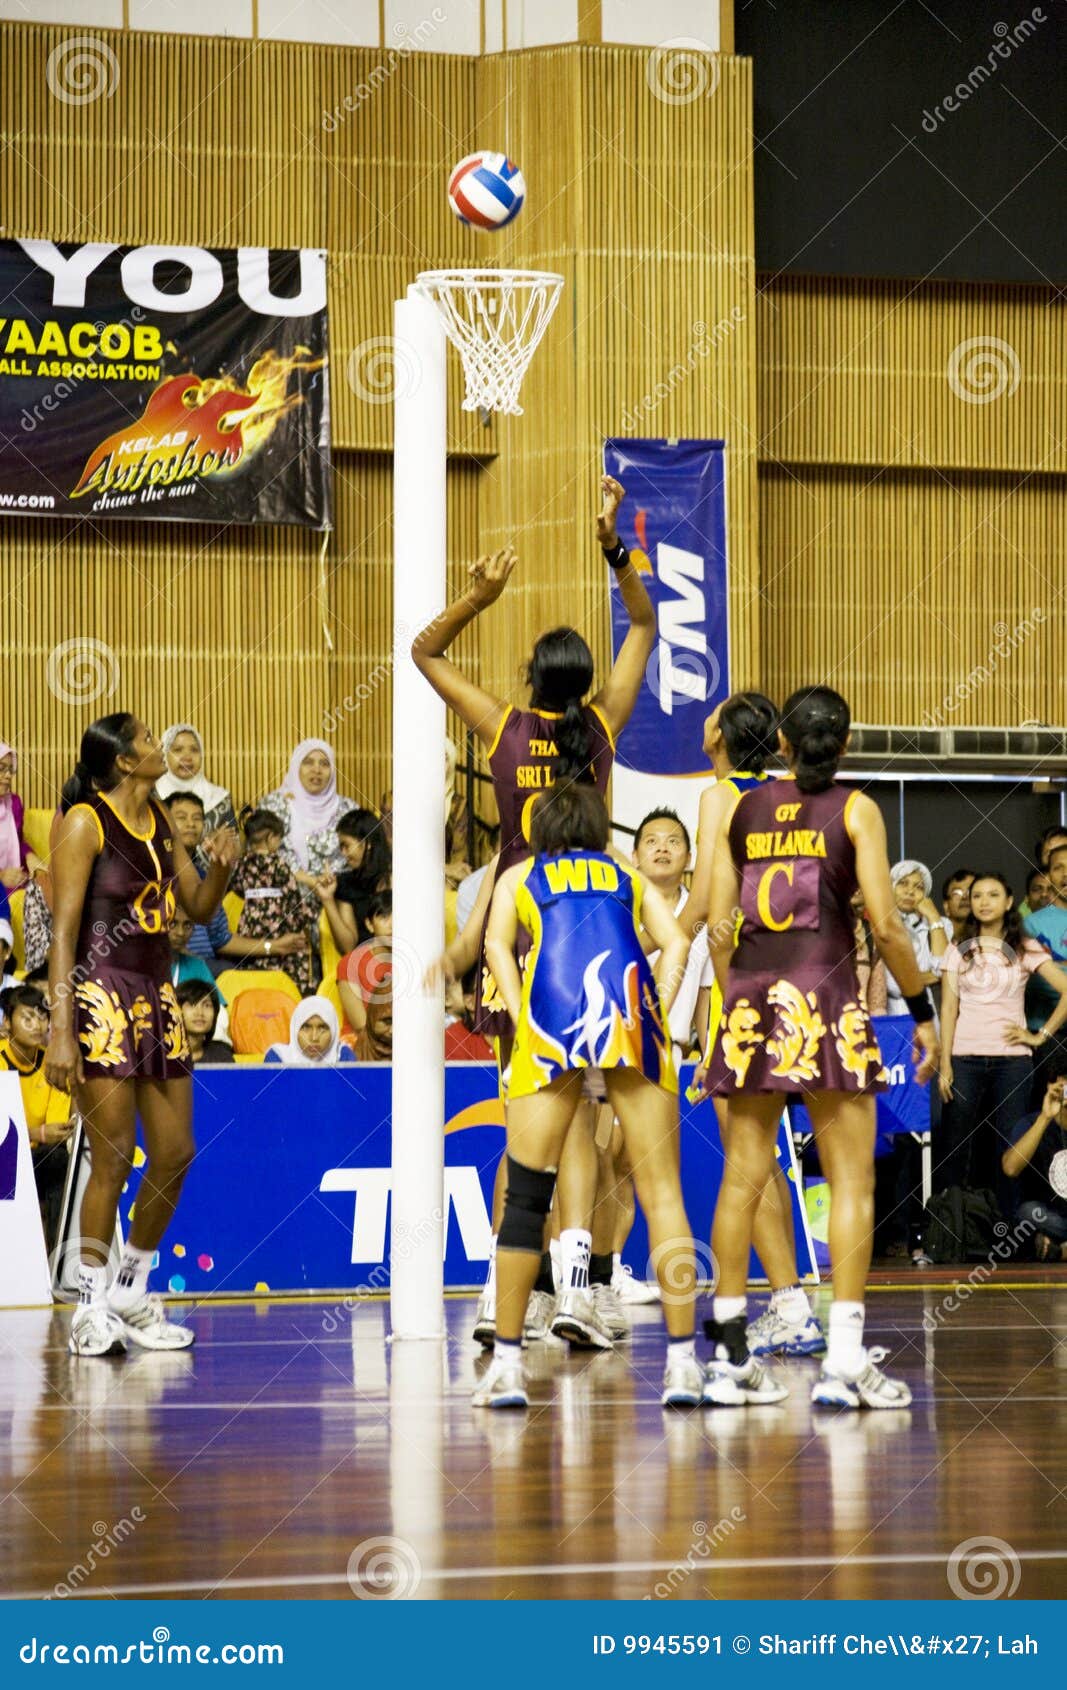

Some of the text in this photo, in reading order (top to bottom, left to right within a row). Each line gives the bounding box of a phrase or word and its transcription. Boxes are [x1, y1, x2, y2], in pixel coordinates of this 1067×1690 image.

[17, 238, 328, 318] YOU
[0, 318, 164, 361] AACOB
[37, 361, 161, 381] ASSOCIATION
[118, 431, 189, 455] KELAB
[140, 485, 165, 502] the
[656, 542, 707, 716] TM
[529, 739, 560, 756] THA
[516, 765, 543, 788] SRI
[775, 802, 802, 822] GY
[746, 829, 828, 860] SRI LANKA
[543, 858, 619, 894] WD
[757, 861, 795, 932] C
